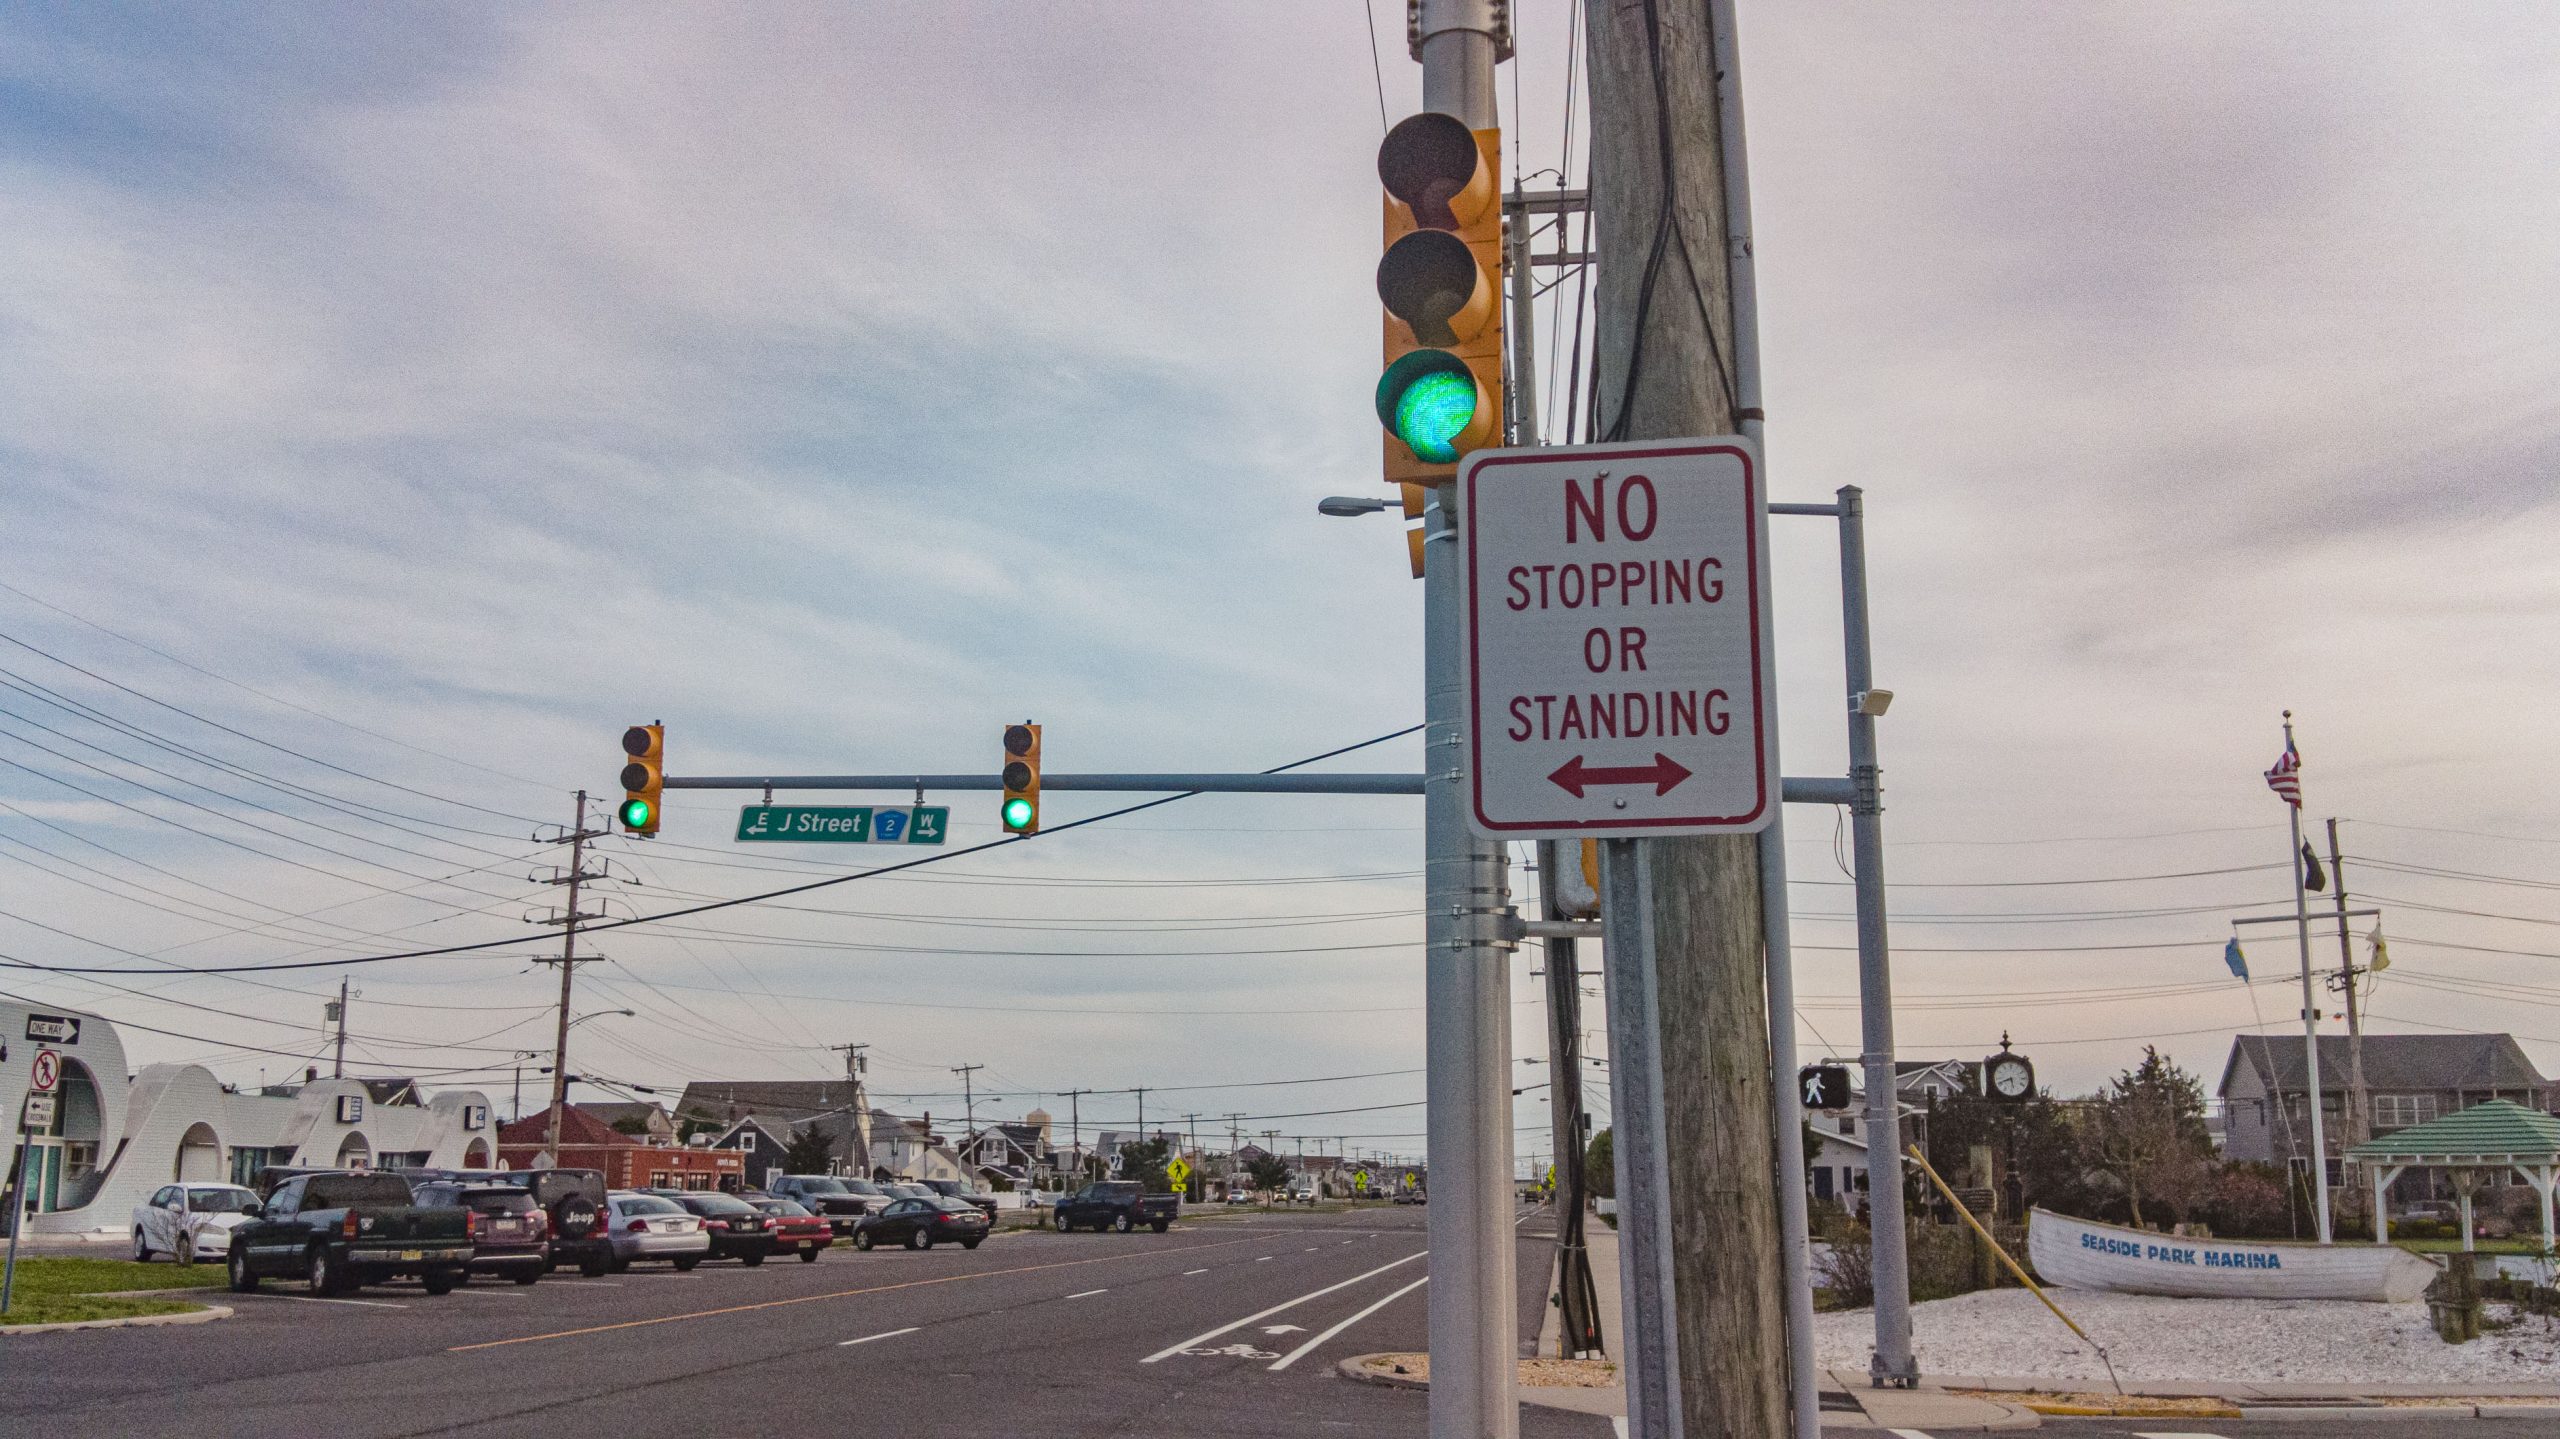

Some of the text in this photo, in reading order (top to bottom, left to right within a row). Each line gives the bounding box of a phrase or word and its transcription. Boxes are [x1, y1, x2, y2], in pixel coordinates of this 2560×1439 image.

[1564, 474, 1658, 544] NO
[1506, 557, 1724, 611] STOPPING
[1583, 626, 1648, 674] OR
[1507, 688, 1730, 742] STANDING
[757, 812, 934, 833] E J Street 2 W
[31, 1021, 65, 1036] ONE WAY
[566, 1211, 595, 1225] Jeep
[2081, 1232, 2282, 1269] SEASIDE PARK MARINA
